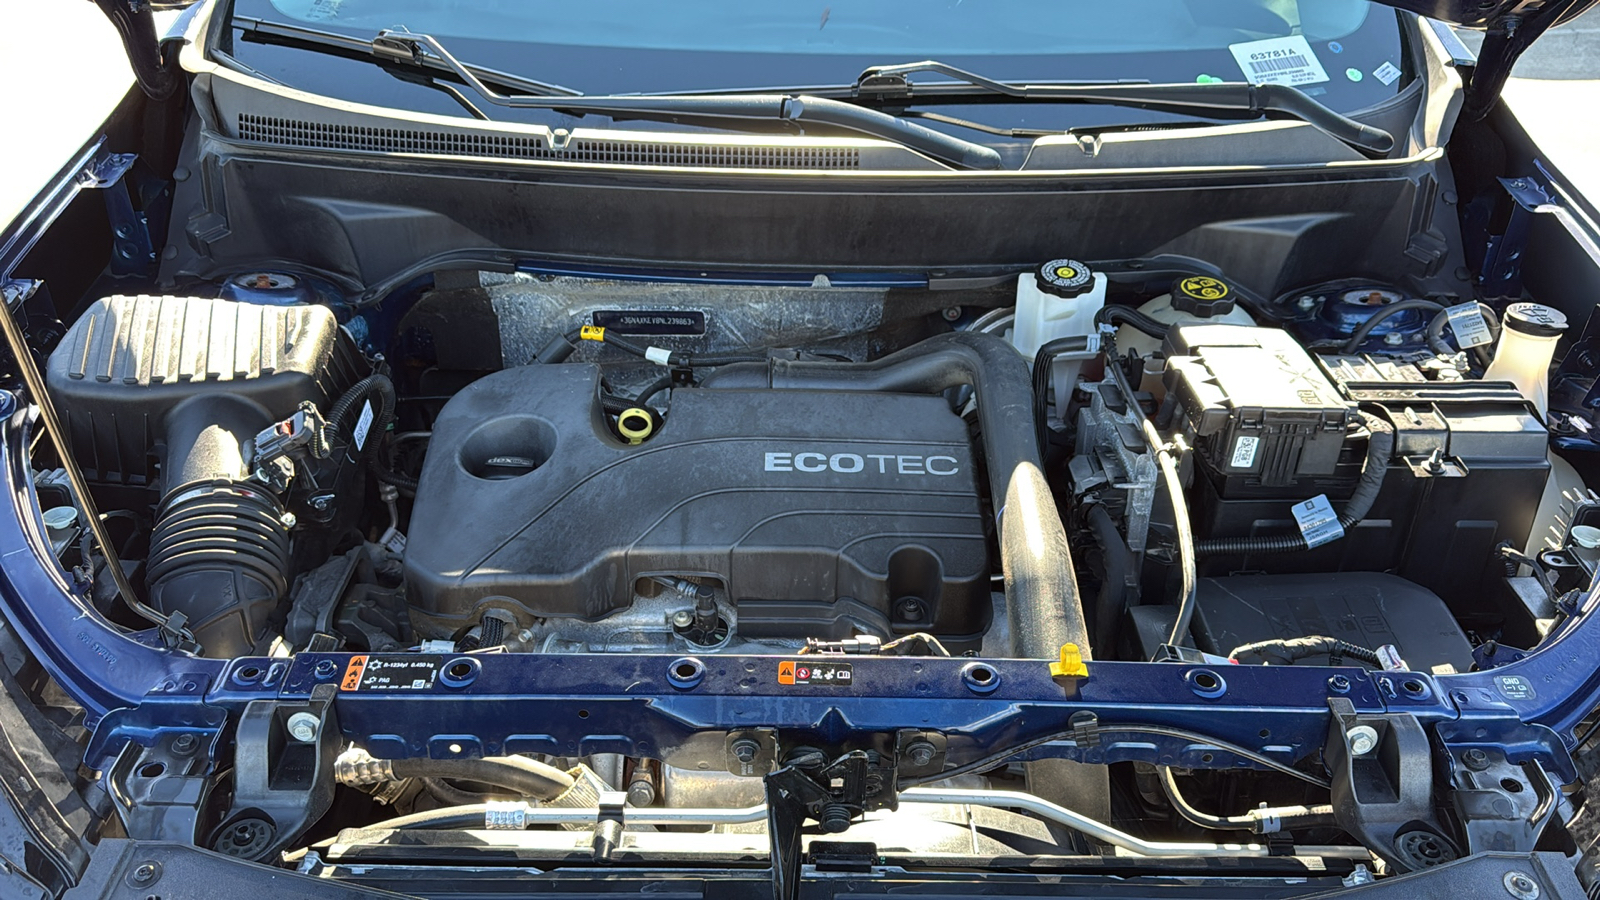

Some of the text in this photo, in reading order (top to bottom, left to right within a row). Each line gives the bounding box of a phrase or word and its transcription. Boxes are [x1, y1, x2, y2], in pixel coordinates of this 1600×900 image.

[1250, 48, 1296, 60] 63781A
[764, 452, 959, 475] ECOTEC
[1502, 677, 1520, 685] GND
